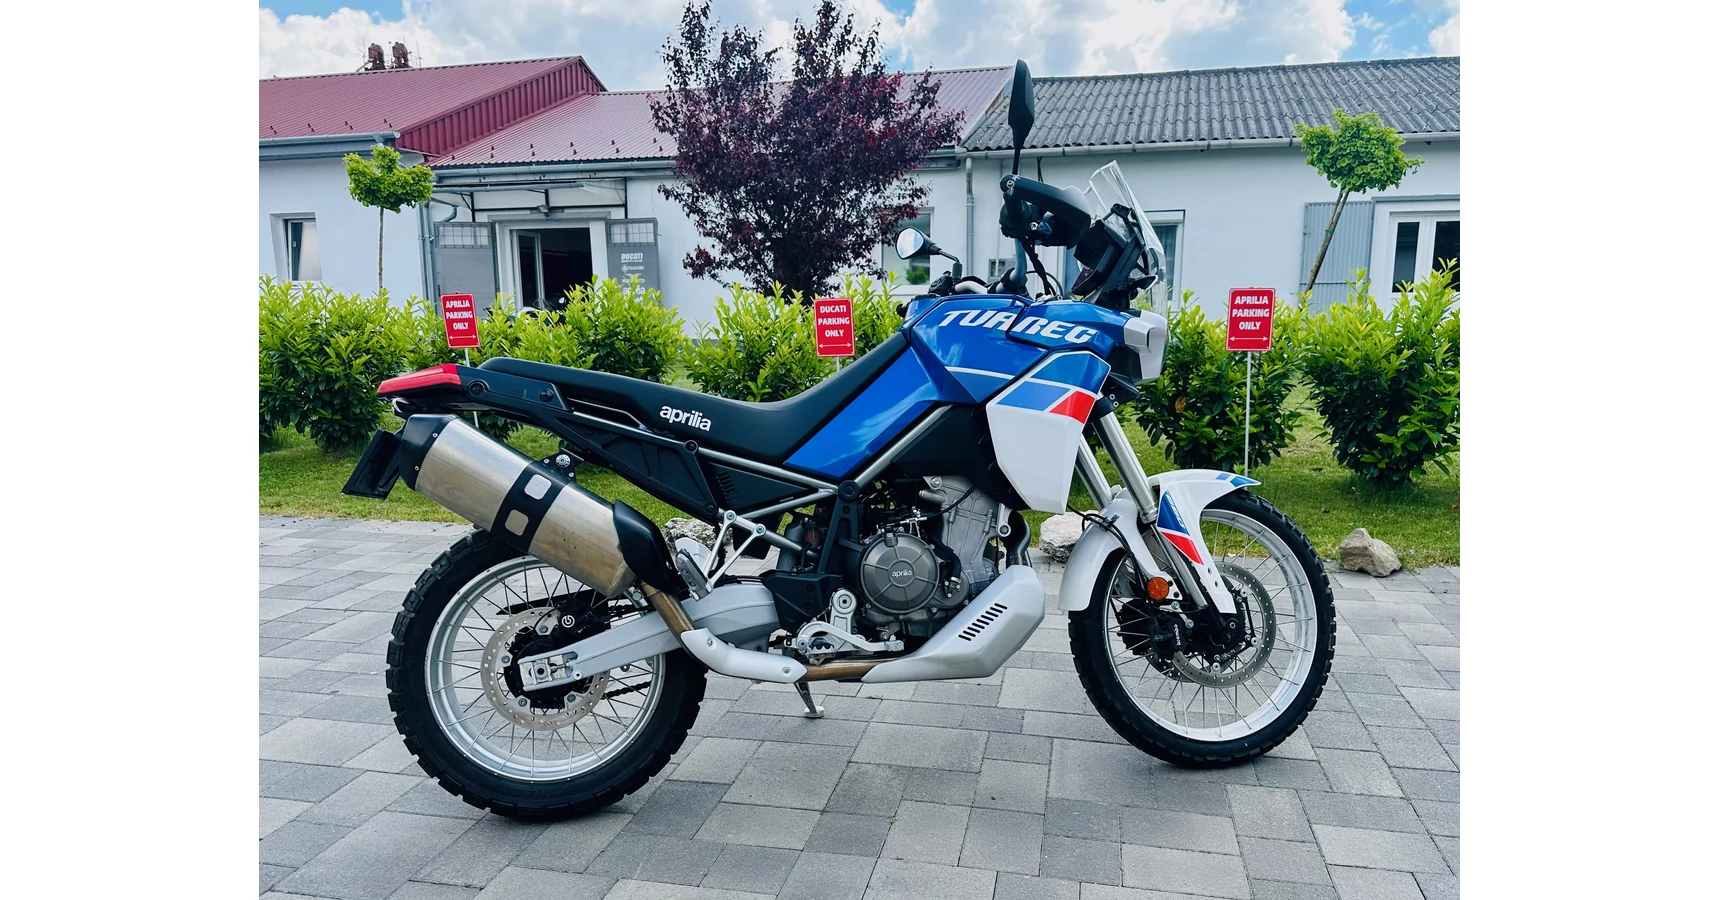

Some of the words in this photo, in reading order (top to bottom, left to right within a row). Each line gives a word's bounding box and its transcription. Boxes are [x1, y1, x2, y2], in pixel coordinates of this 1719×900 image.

[445, 300, 471, 309] APRILIA
[1234, 296, 1269, 305] APRILIA
[820, 305, 847, 313] DUCATI
[1232, 309, 1270, 318] PARKING
[445, 311, 474, 320] PARKING
[817, 317, 850, 325] PARKING
[1239, 321, 1262, 330] ONLY
[452, 322, 469, 330] ONLY
[938, 309, 1098, 344] TUAREG
[824, 329, 845, 337] ONLY
[659, 405, 712, 432] aprilia
[891, 569, 913, 578] aprilia
